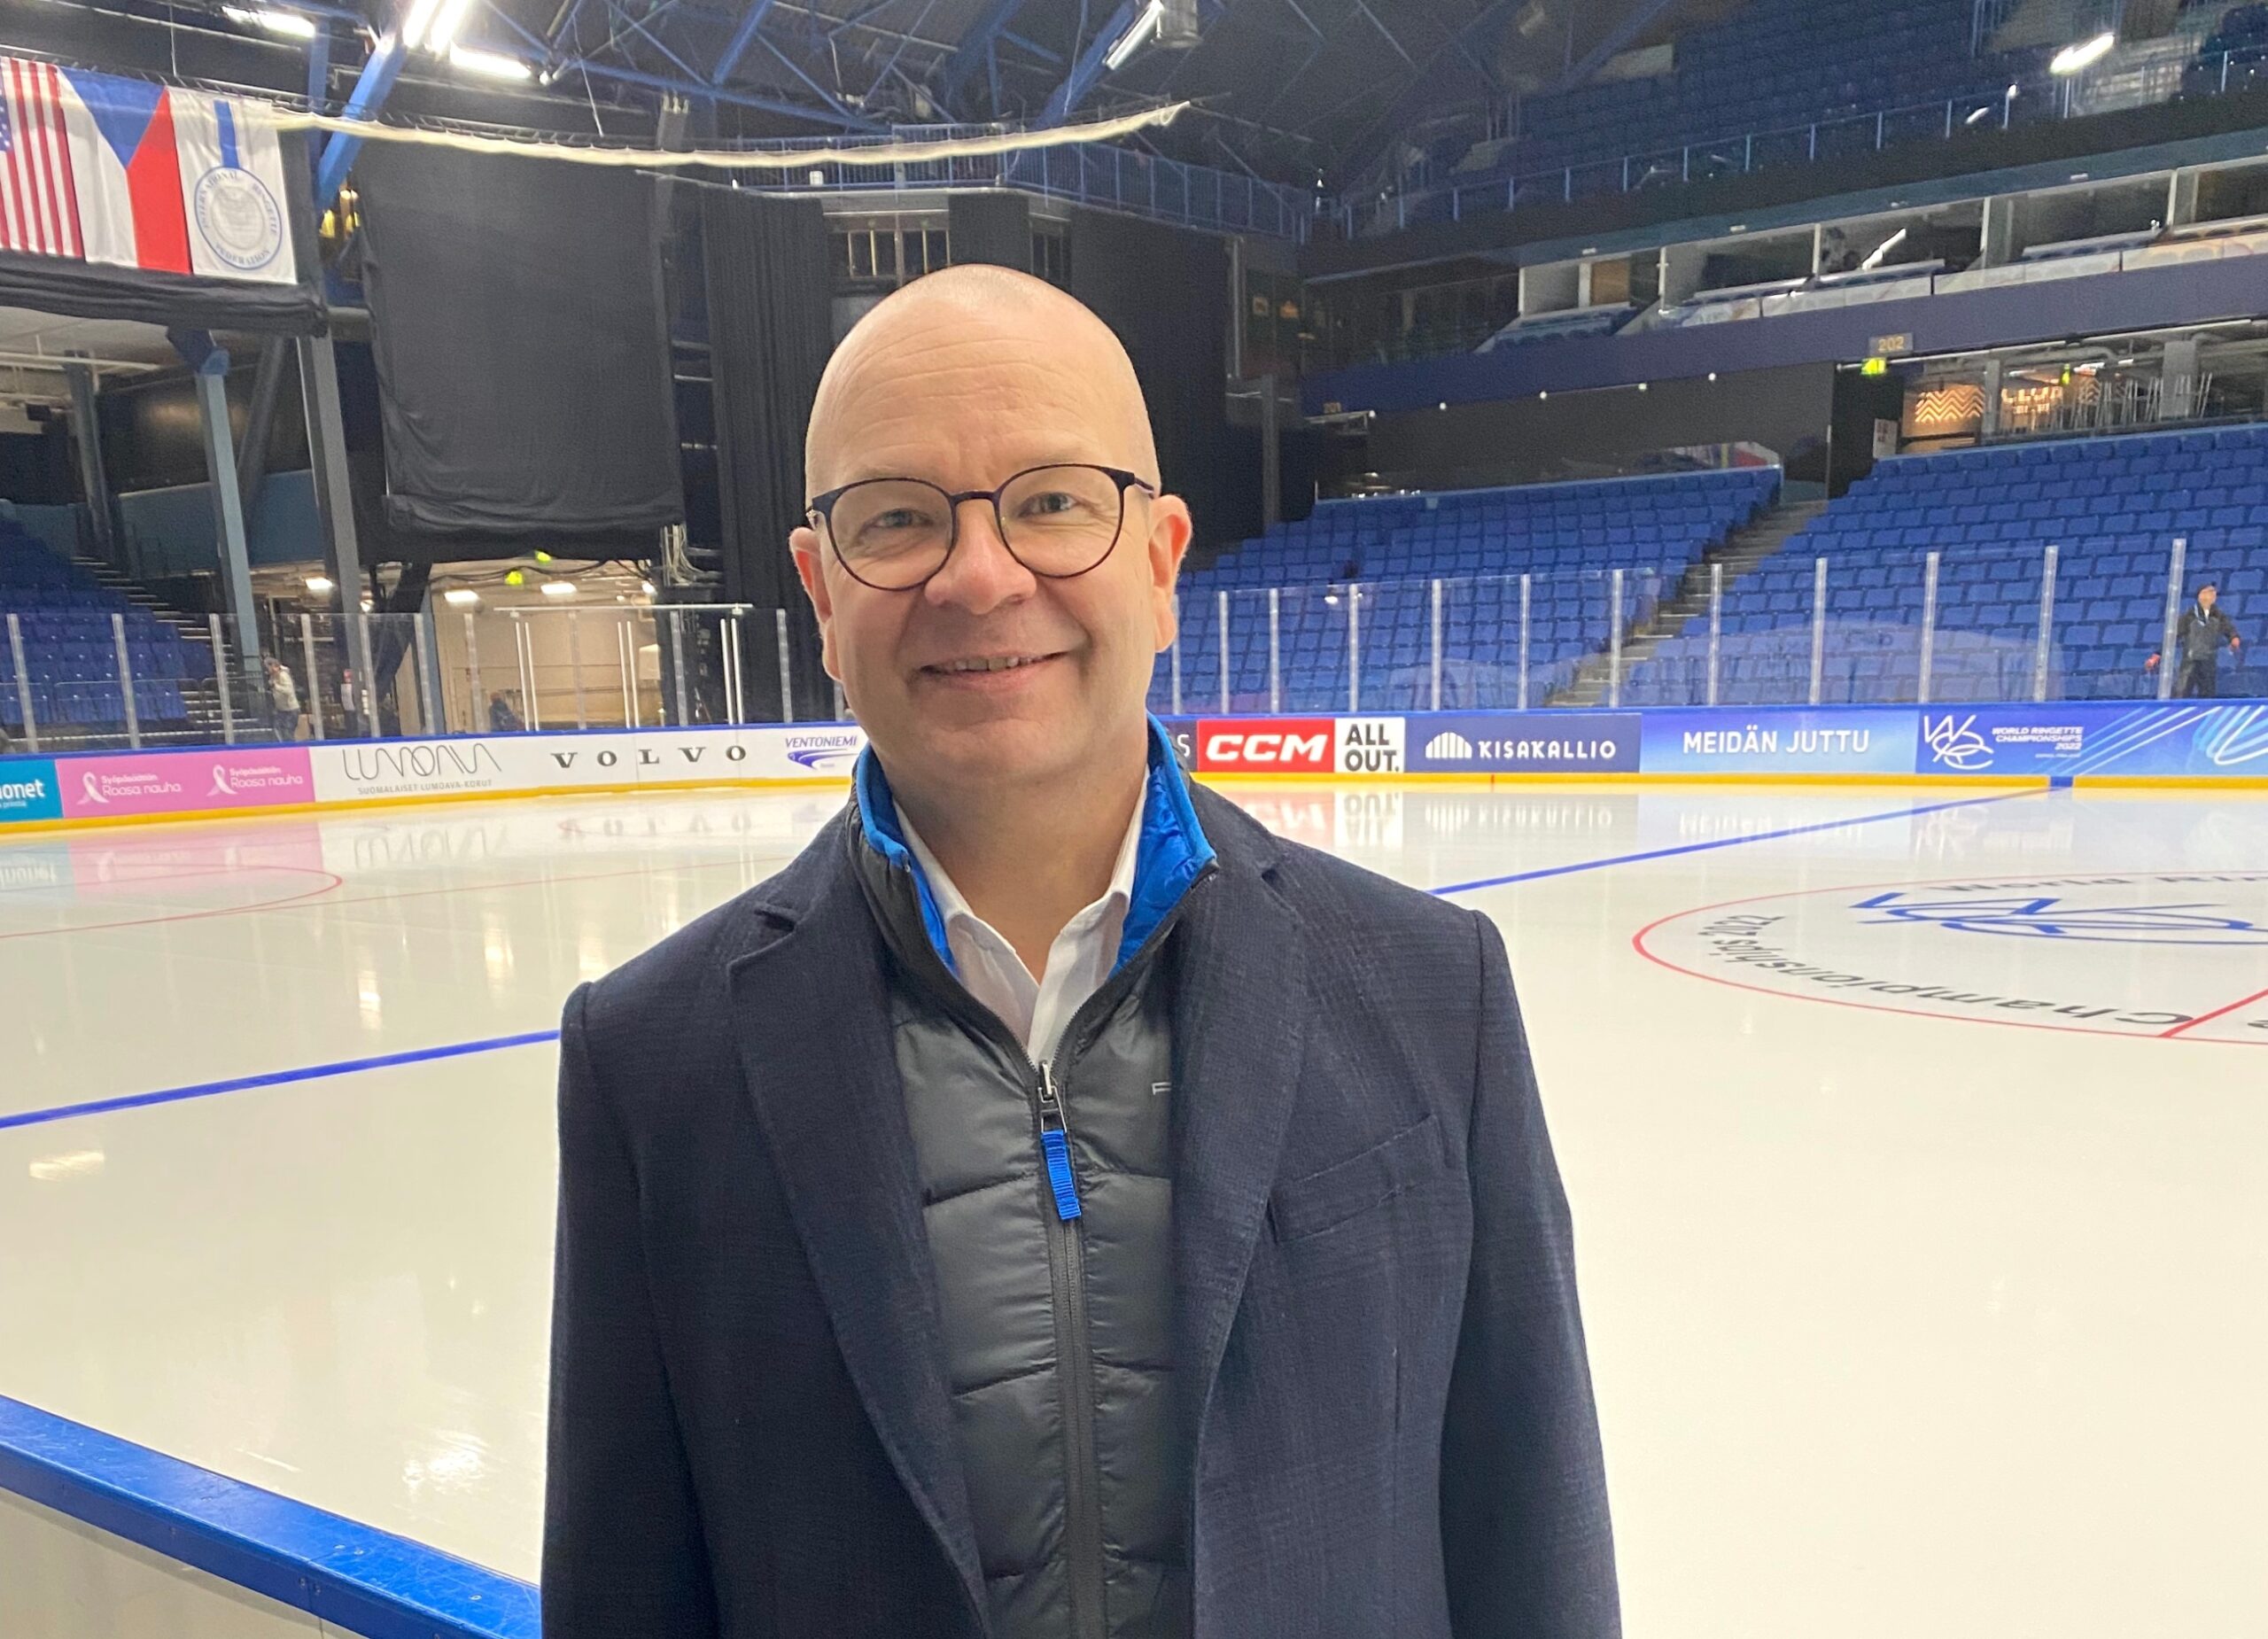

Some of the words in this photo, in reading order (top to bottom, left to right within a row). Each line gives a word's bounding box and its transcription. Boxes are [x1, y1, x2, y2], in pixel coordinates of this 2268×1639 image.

[1877, 336, 1905, 353] 202
[1344, 723, 1390, 746] ALL
[1682, 724, 1777, 754] MEIDÄN
[1785, 729, 1869, 753] JUTTU
[1992, 726, 2030, 735] WORLD
[2031, 726, 2084, 734] RINGETTE
[785, 734, 858, 748] VENTONIEMI
[1206, 734, 1329, 762] CCM
[1478, 740, 1616, 759] KISAKALLIO
[550, 744, 747, 769] VOLVO
[1344, 749, 1400, 773] OUT.
[102, 784, 142, 796] Roasa
[144, 781, 182, 795] nauha
[230, 776, 266, 788] Roasa
[268, 774, 304, 786] nauha
[357, 783, 418, 796] SUOMALAISET
[1697, 914, 1786, 936] 2022
[1707, 939, 2194, 1024] Championships
